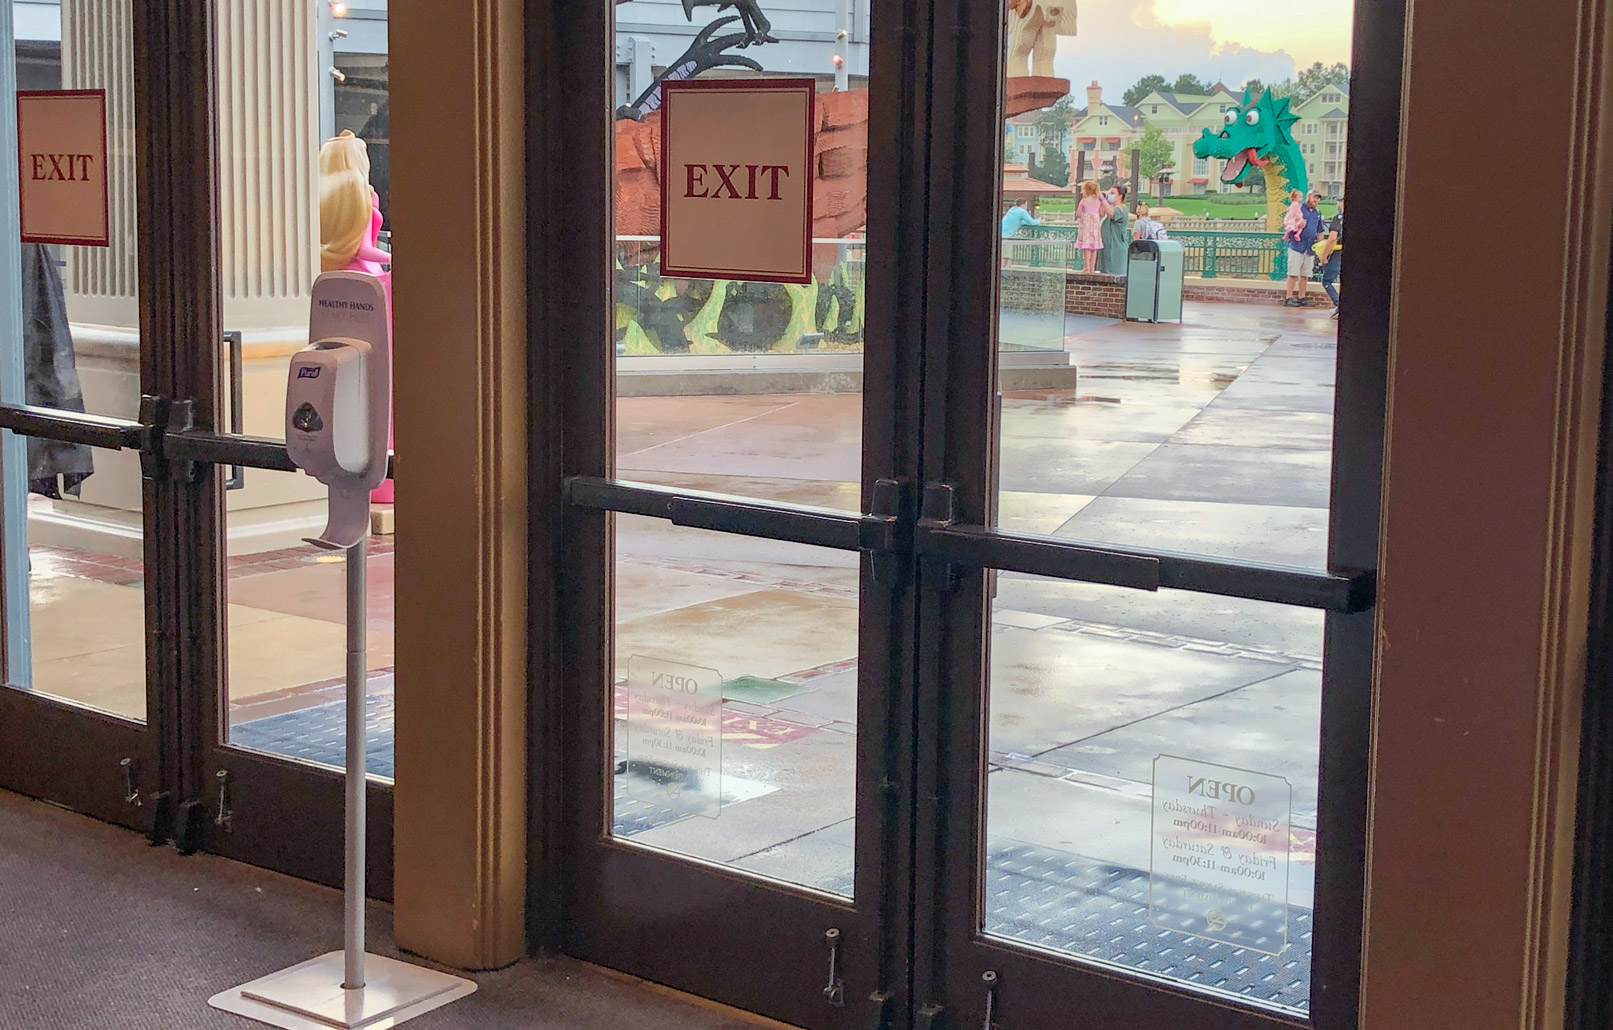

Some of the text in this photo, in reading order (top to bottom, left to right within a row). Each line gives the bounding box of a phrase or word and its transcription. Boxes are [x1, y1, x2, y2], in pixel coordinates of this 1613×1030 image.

[31, 153, 94, 182] EXIT
[683, 163, 790, 201] EXIT
[318, 299, 375, 312] HEALTHY HANDS
